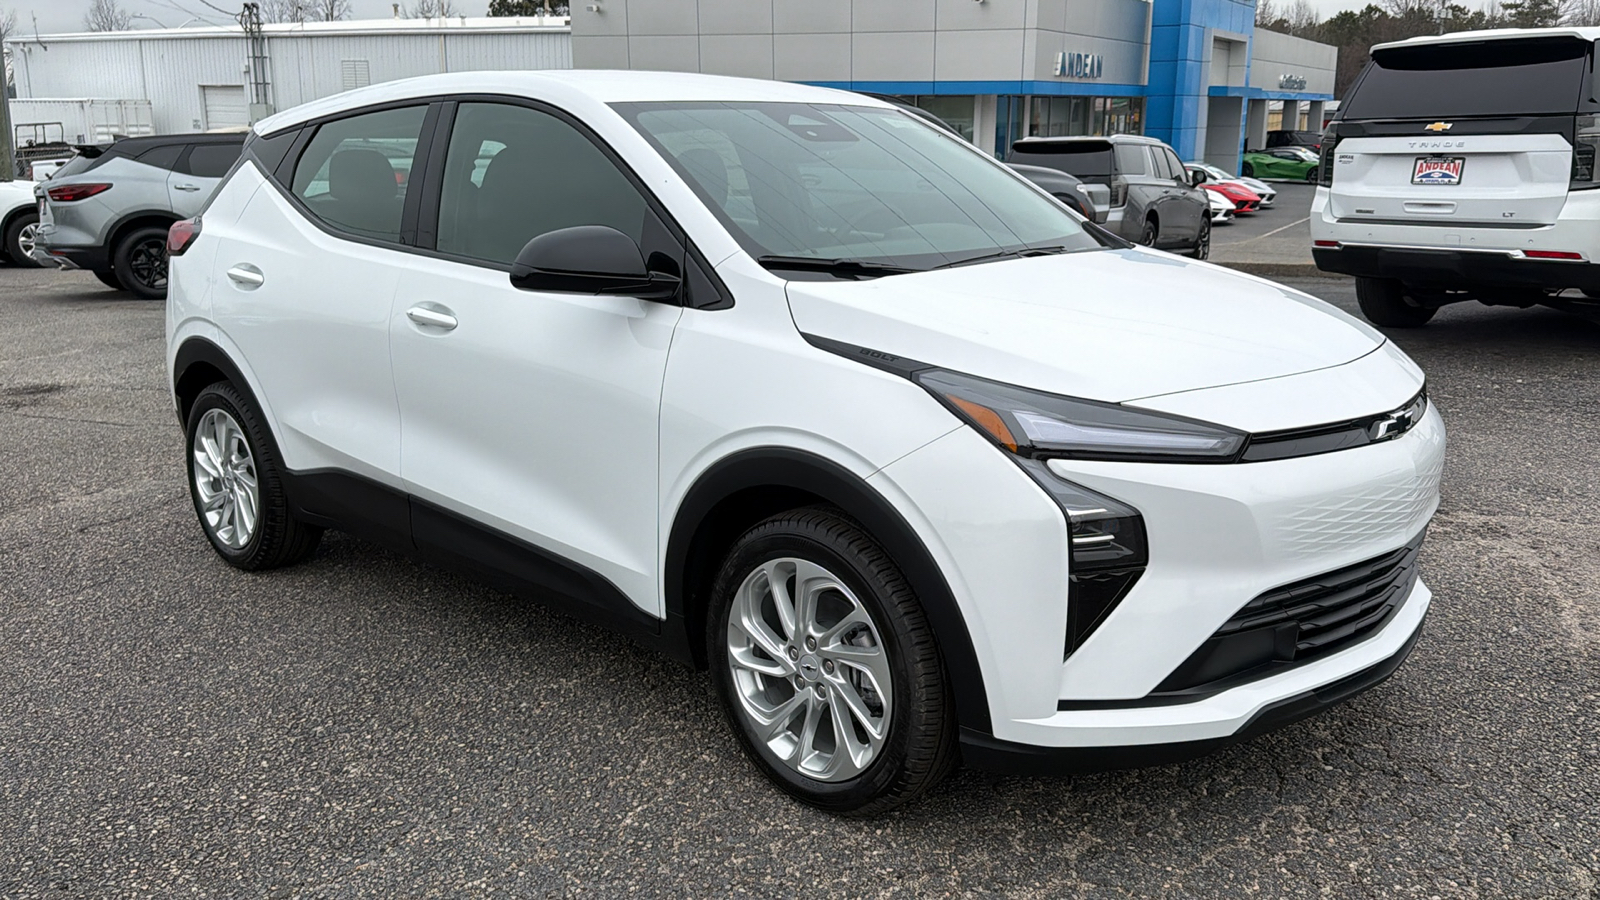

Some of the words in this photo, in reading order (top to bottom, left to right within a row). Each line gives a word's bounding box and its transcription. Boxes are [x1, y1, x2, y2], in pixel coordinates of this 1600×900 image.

[1055, 52, 1103, 78] ANDEAN
[1416, 162, 1461, 177] ANDEAN
[860, 348, 899, 362] BOLT
